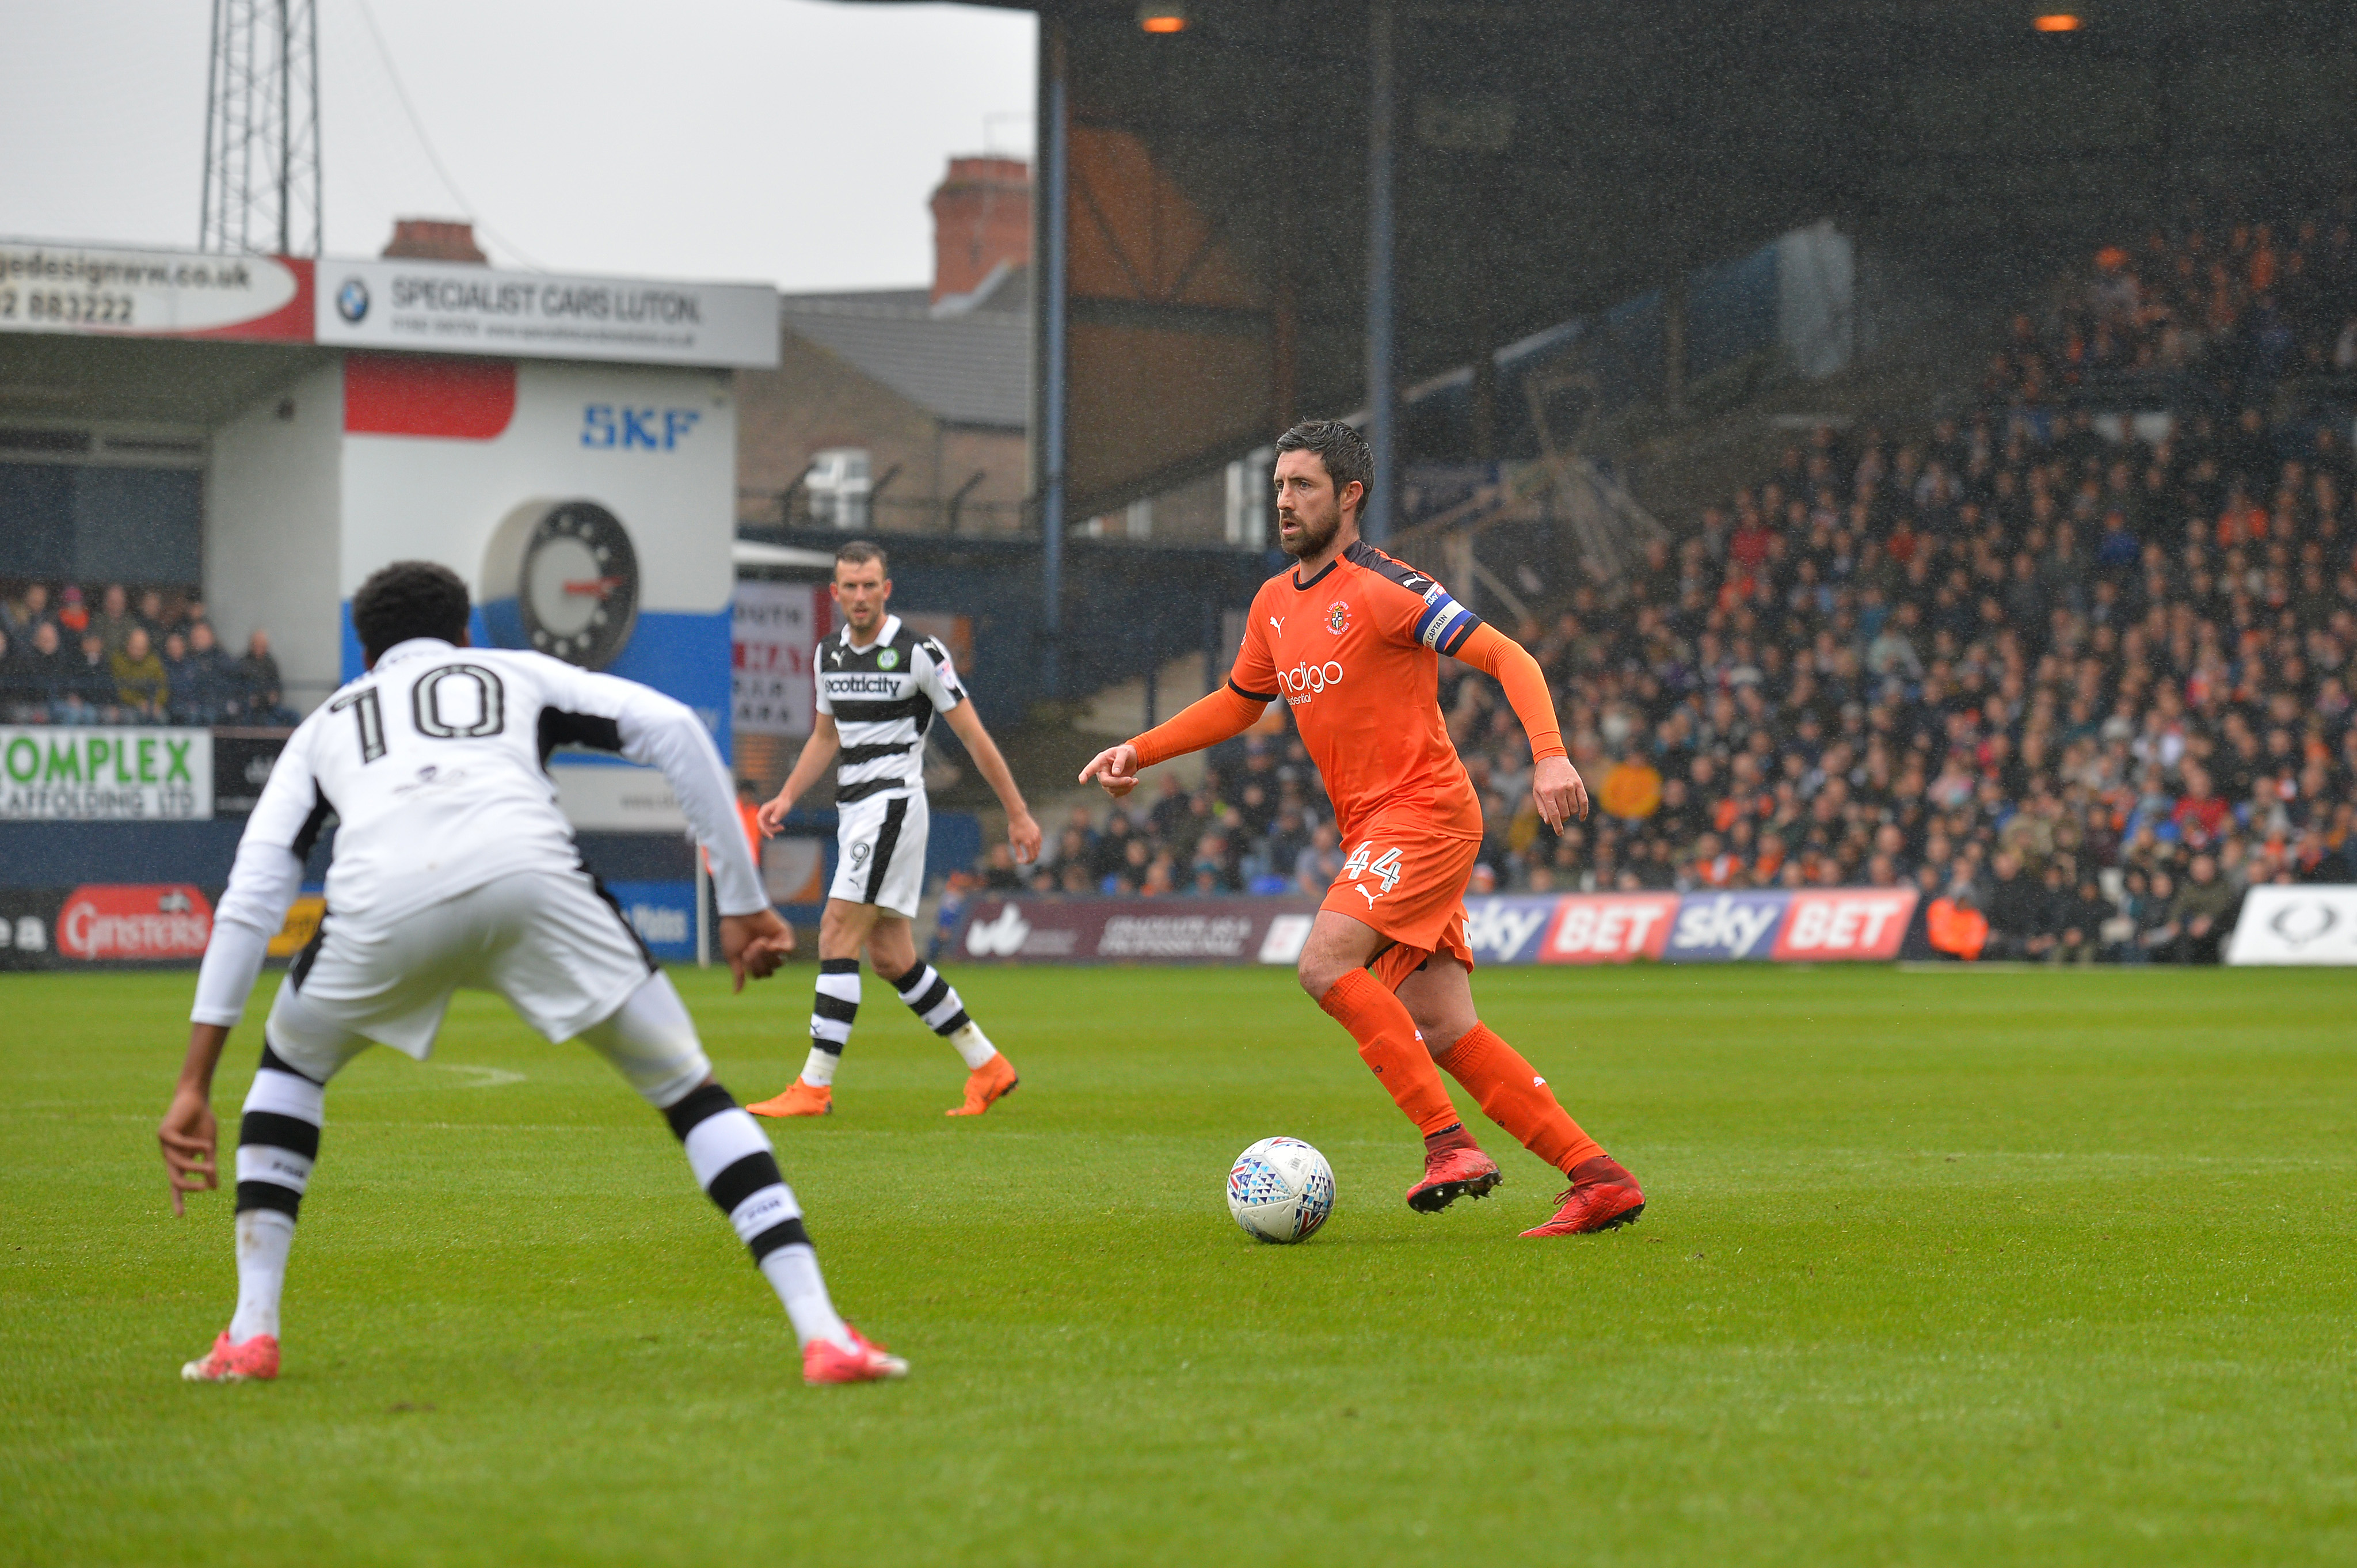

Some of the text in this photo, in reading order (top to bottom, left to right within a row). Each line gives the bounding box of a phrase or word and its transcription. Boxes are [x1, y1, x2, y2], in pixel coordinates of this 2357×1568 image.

[391, 277, 535, 317] SPECIALIST
[540, 286, 612, 321] CARS
[581, 405, 700, 451] SKF
[1427, 614, 1448, 641] CAPTAIN
[825, 676, 901, 697] ecotricity
[330, 664, 505, 764] 10
[0, 736, 192, 783] OMPLEX
[850, 842, 870, 871] 9
[1343, 841, 1403, 893] 44
[1557, 904, 1666, 953] BET
[1674, 896, 1780, 960] sky
[1787, 900, 1901, 949] BET
